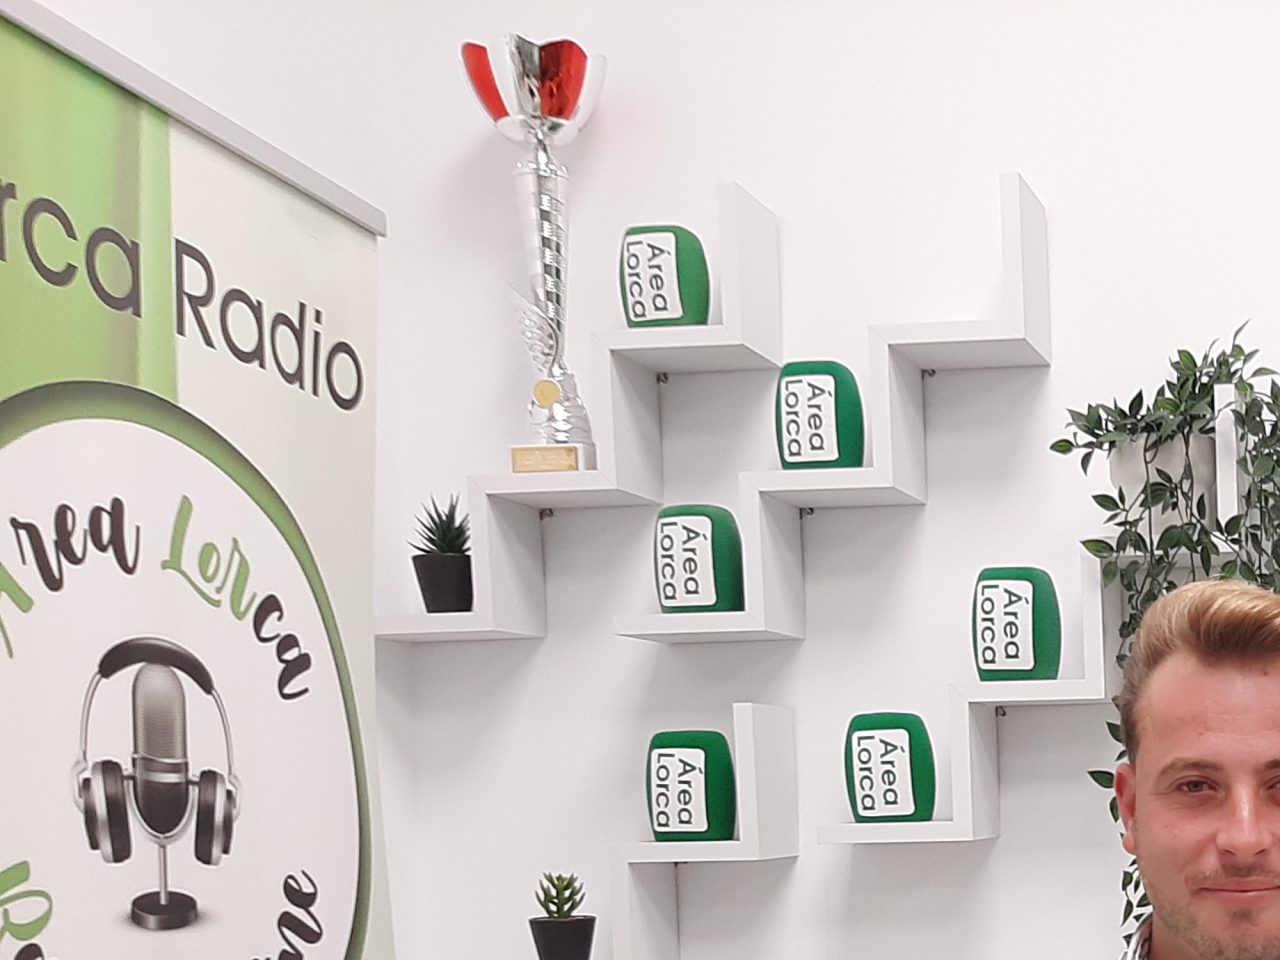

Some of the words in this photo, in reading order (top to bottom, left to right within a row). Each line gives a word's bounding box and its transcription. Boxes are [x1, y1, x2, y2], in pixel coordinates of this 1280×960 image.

[0, 178, 142, 319] rca
[174, 238, 364, 412] Radio
[626, 240, 647, 320] Lorca
[646, 241, 671, 314] Área
[785, 379, 804, 458] Lorca
[806, 381, 833, 452] Área
[161, 494, 312, 701] Lorca
[659, 521, 678, 601] Lorca
[681, 524, 708, 596] Área
[981, 584, 1000, 665] Lorca
[1003, 587, 1030, 660] Área
[656, 752, 676, 829] Lorca
[677, 757, 704, 826] Área
[857, 735, 876, 811] Lorca
[879, 737, 906, 807] Área
